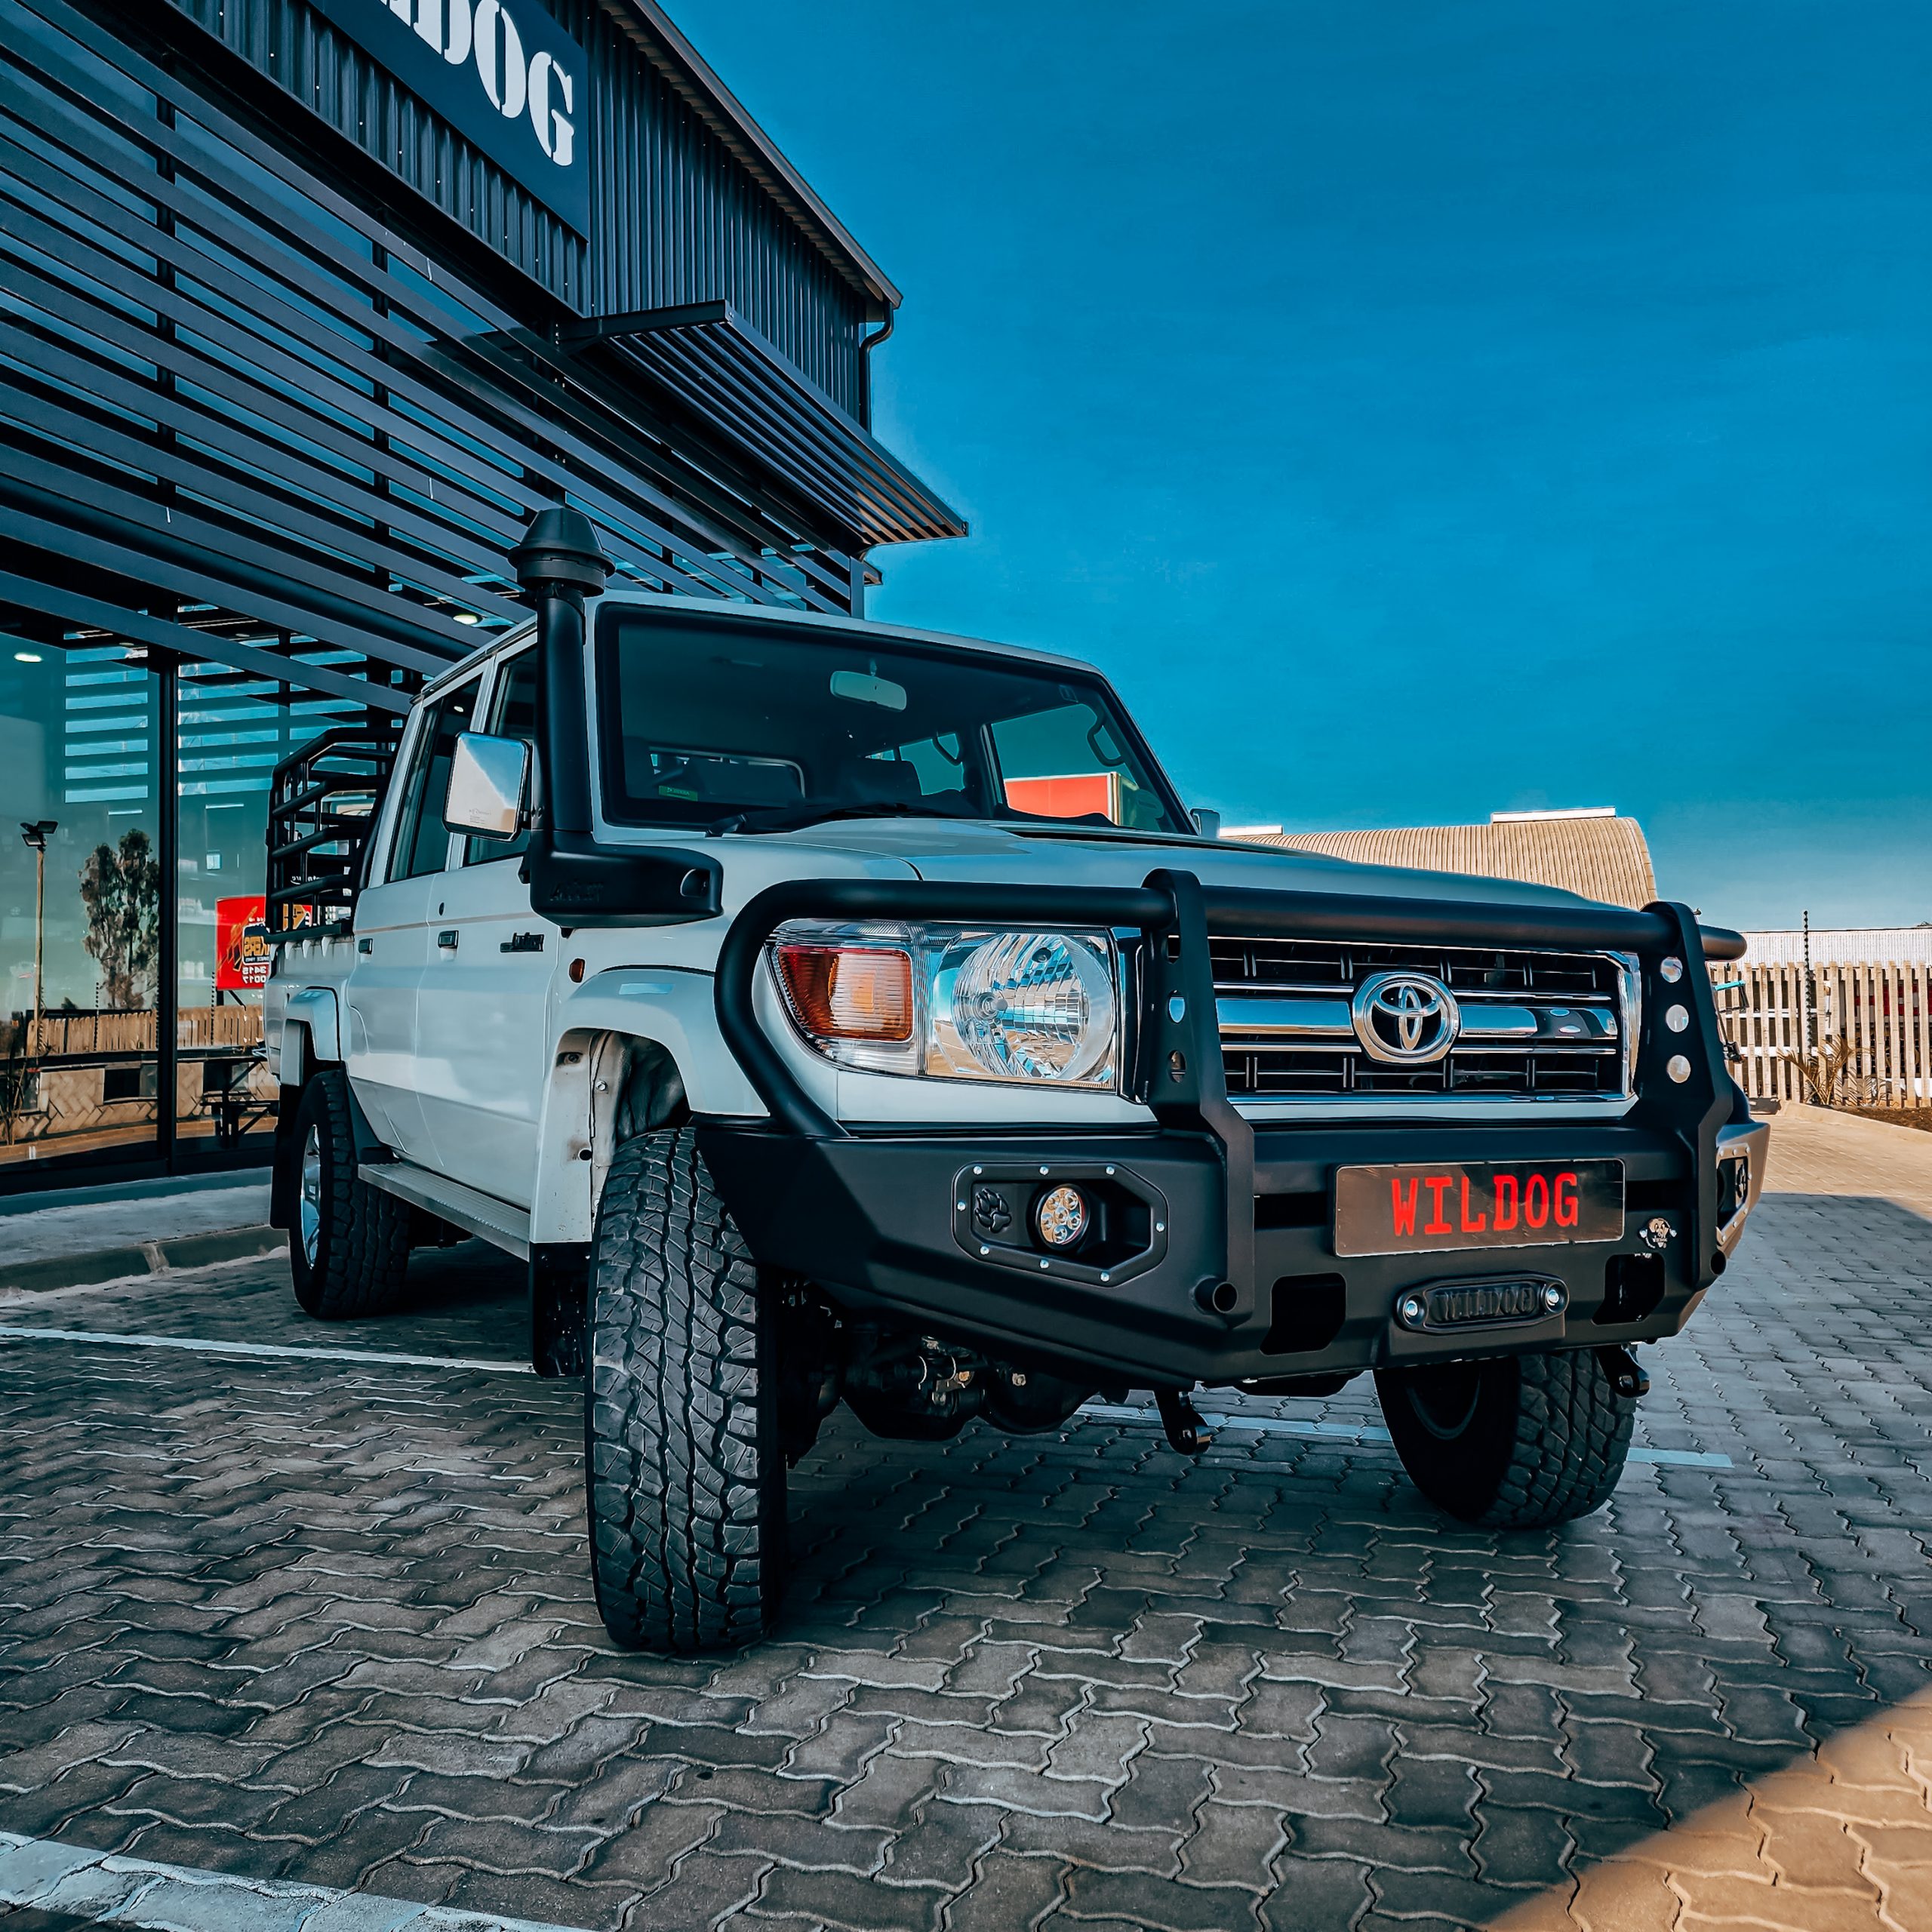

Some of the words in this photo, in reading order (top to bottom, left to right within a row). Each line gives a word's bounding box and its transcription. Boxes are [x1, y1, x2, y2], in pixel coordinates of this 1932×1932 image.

[380, 0, 574, 166] DOG
[1391, 1172, 1579, 1237] WILDOG
[1432, 1284, 1537, 1322] WILDOG
